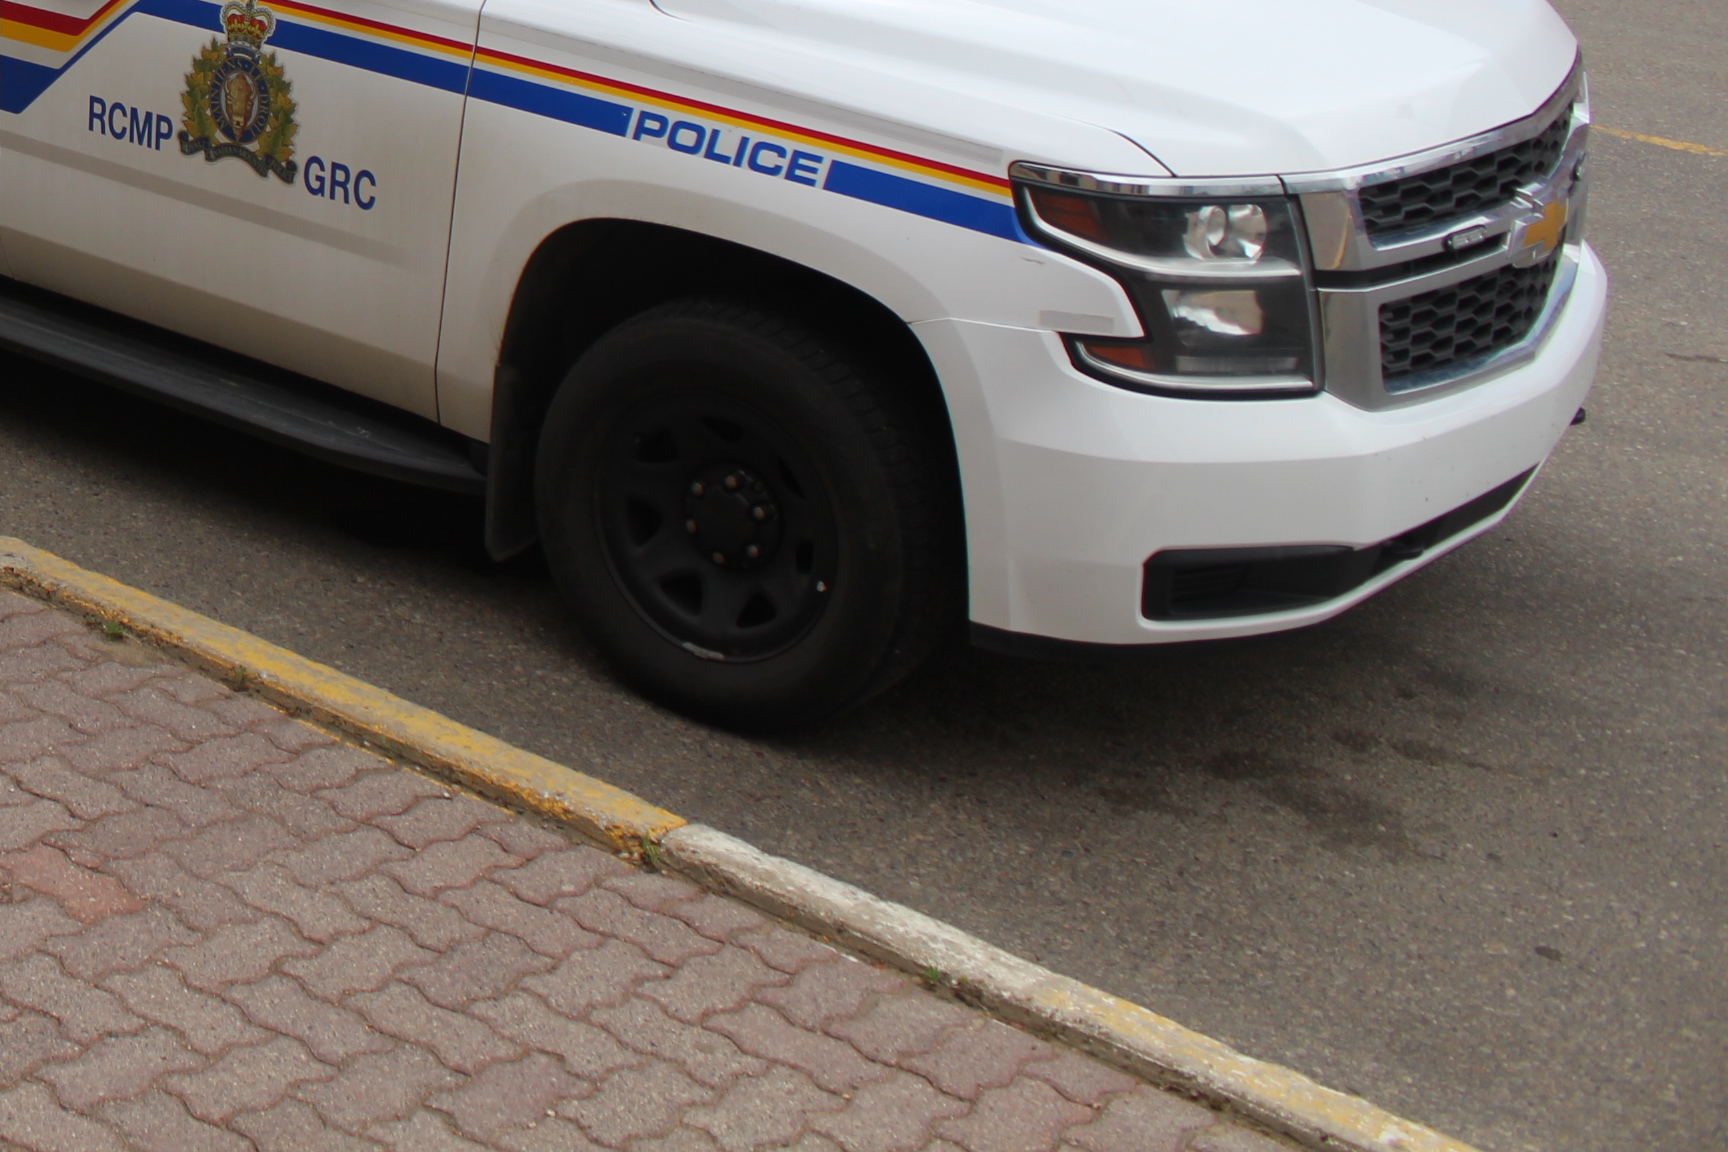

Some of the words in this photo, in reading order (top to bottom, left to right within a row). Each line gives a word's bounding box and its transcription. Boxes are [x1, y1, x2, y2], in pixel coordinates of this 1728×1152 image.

[88, 95, 173, 150] RCMP
[304, 155, 376, 210] GRC
[632, 110, 824, 187] POLICE
